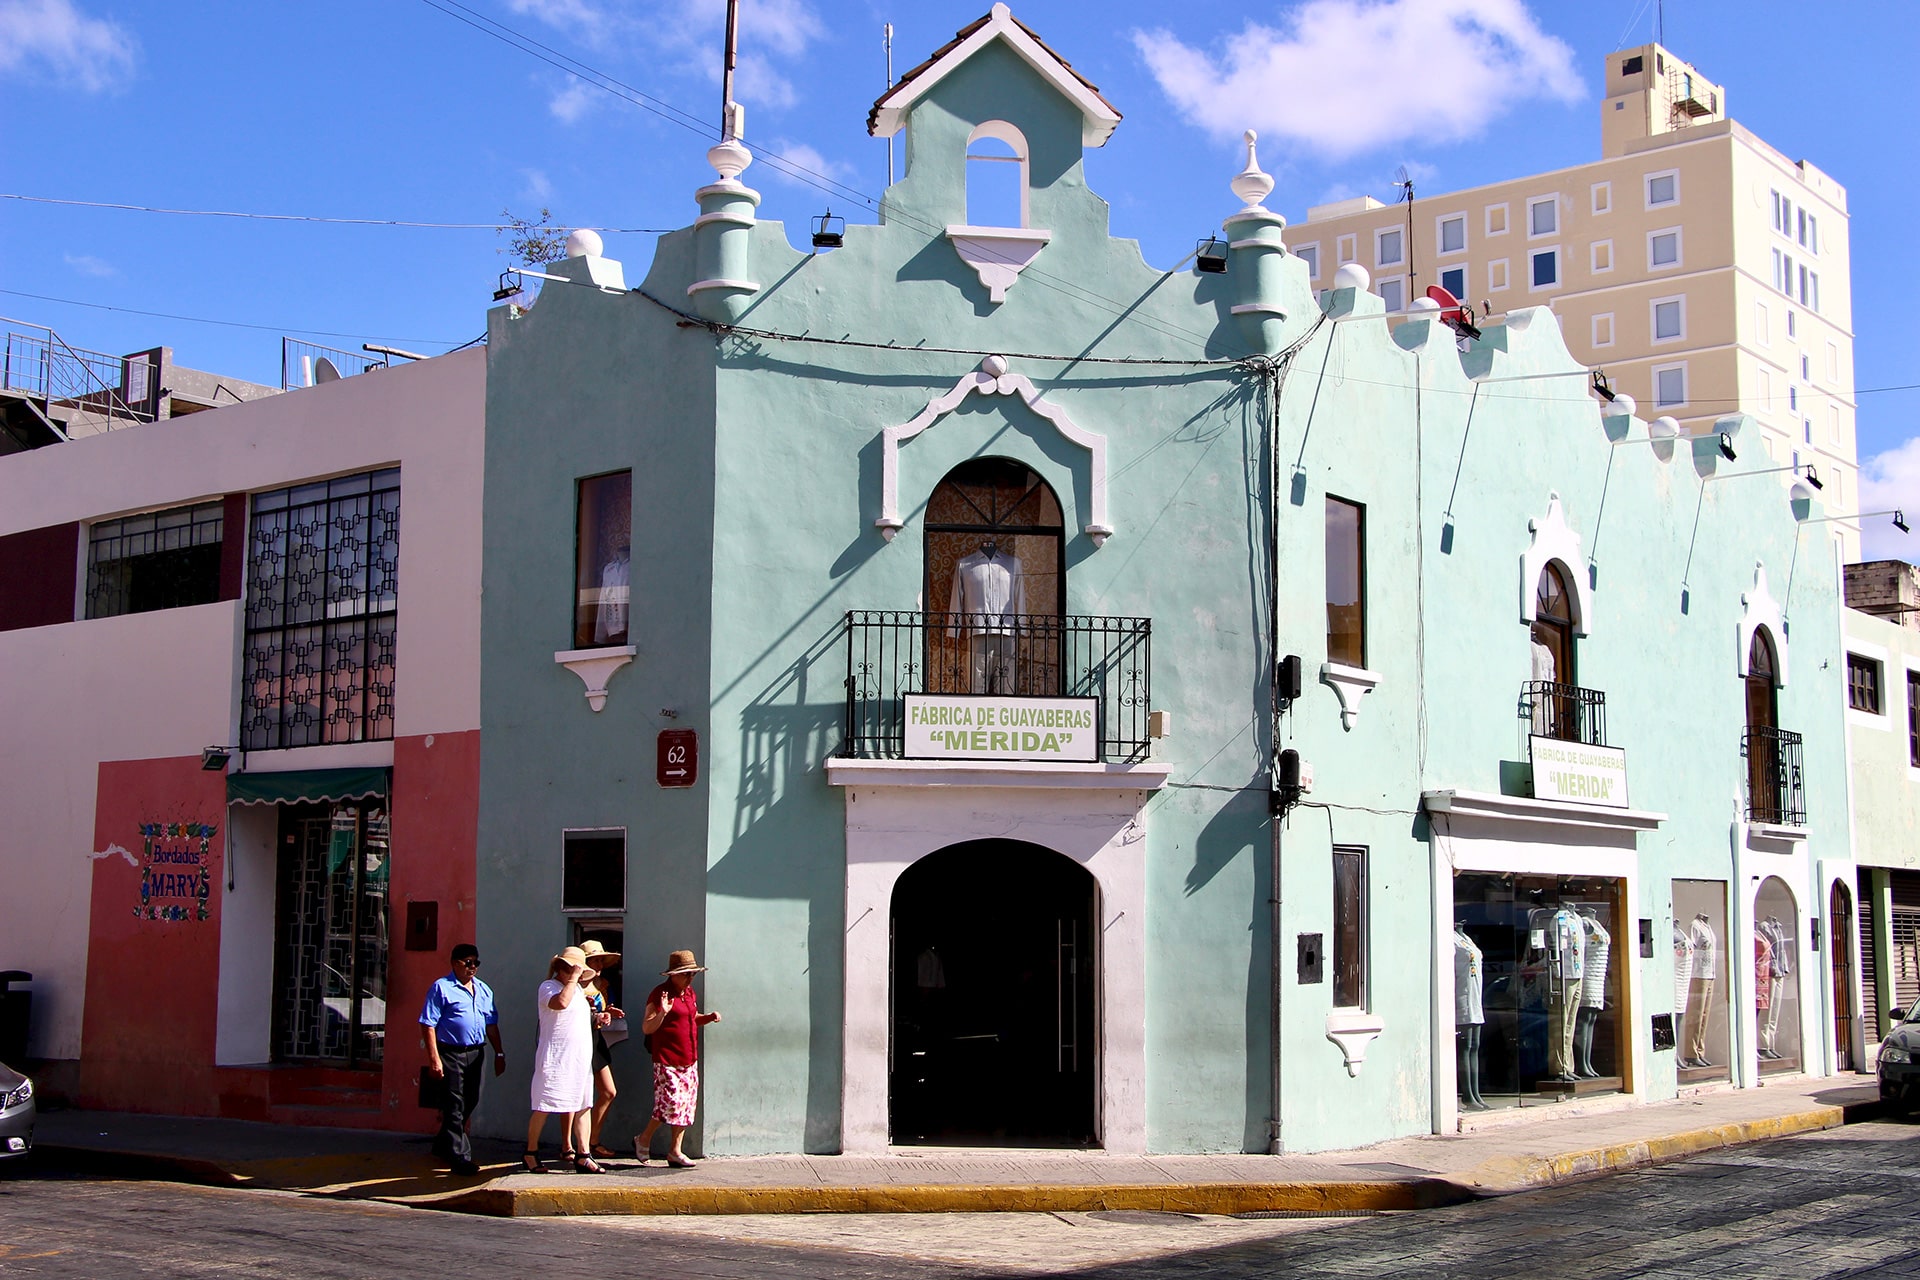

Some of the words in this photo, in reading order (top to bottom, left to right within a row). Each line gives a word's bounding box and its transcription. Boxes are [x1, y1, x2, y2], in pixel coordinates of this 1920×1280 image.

[911, 702, 972, 725] FÁBRICA
[977, 707, 995, 726] DE
[1000, 707, 1092, 728] GUAYABERAS
[929, 727, 1073, 752] “MÉRIDA”
[668, 745, 686, 764] 62
[1568, 751, 1578, 764] DE
[1580, 753, 1624, 770] GUAYABERAS
[153, 845, 200, 864] Bordados
